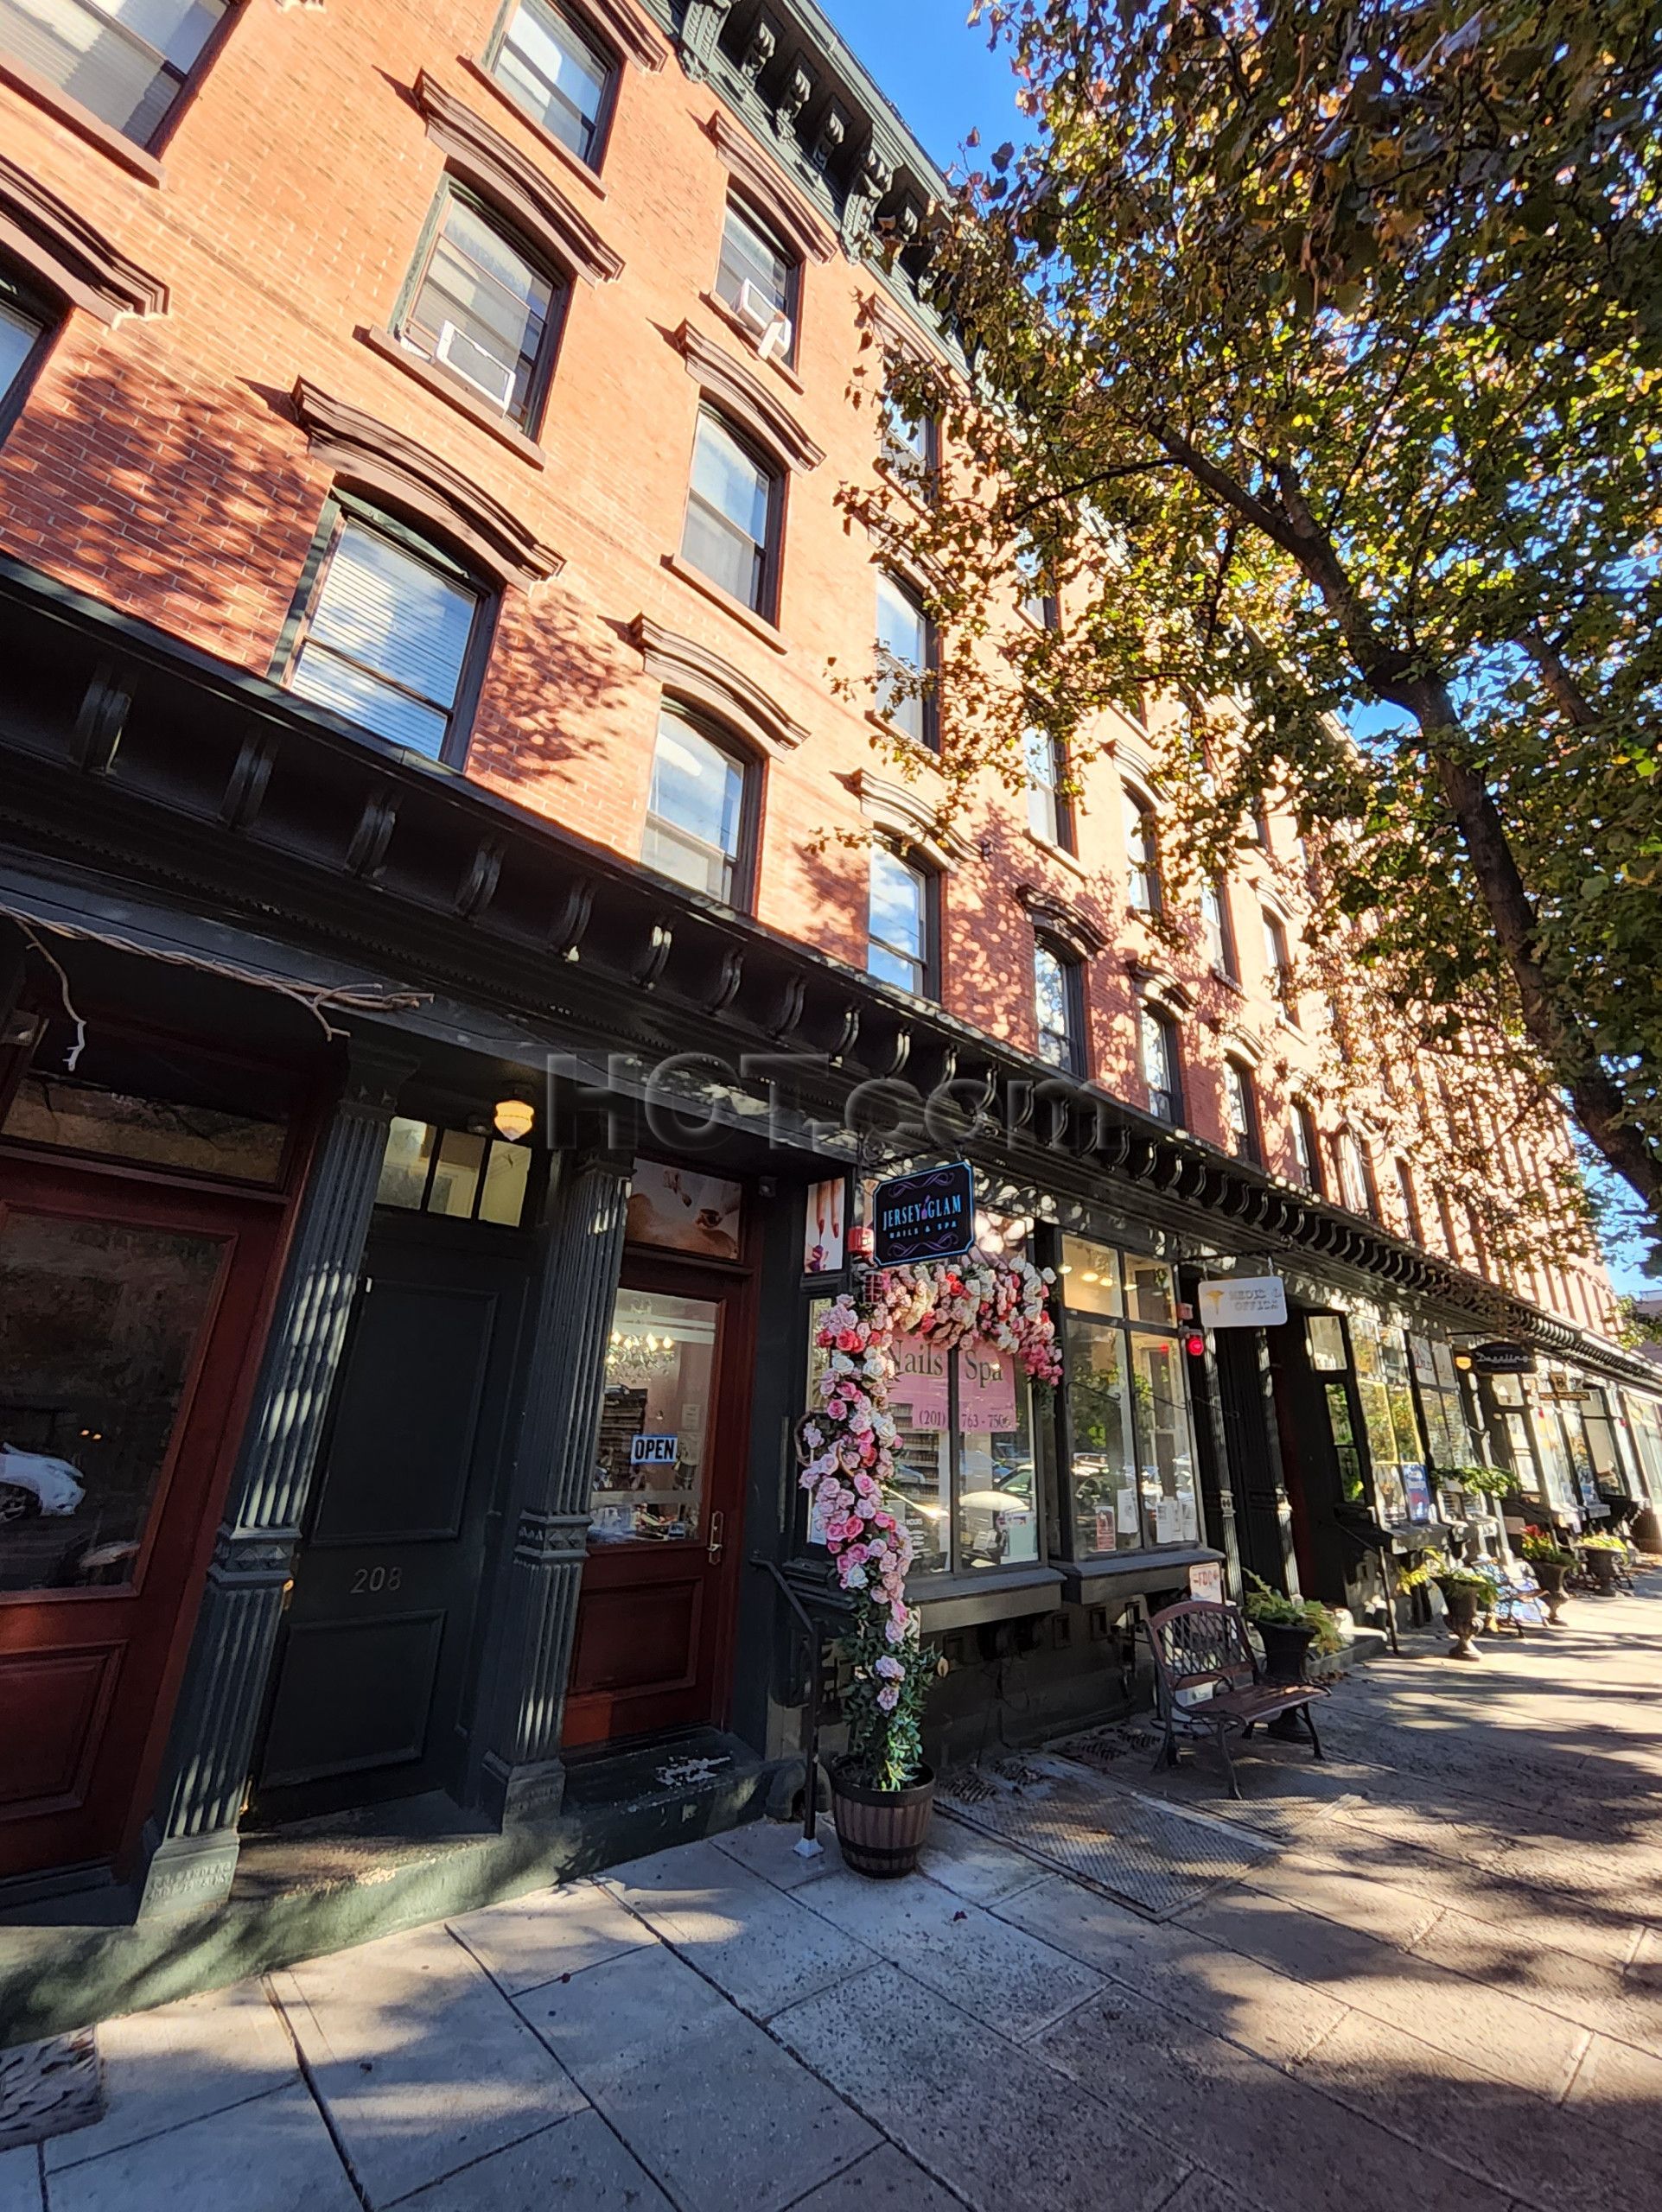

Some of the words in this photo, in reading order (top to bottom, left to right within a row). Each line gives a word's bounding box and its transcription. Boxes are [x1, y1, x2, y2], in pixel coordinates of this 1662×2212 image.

[882, 1203, 922, 1231] JERSEY
[927, 1194, 961, 1218] GLAM
[889, 1227, 919, 1239] NAILS
[938, 1220, 957, 1230] SPA
[888, 1339, 944, 1376] Nails
[965, 1349, 1003, 1389] Spa
[919, 1410, 946, 1425] (201)
[961, 1414, 979, 1427] 763
[634, 1439, 675, 1460] OPEN
[349, 1566, 403, 1594] 208
